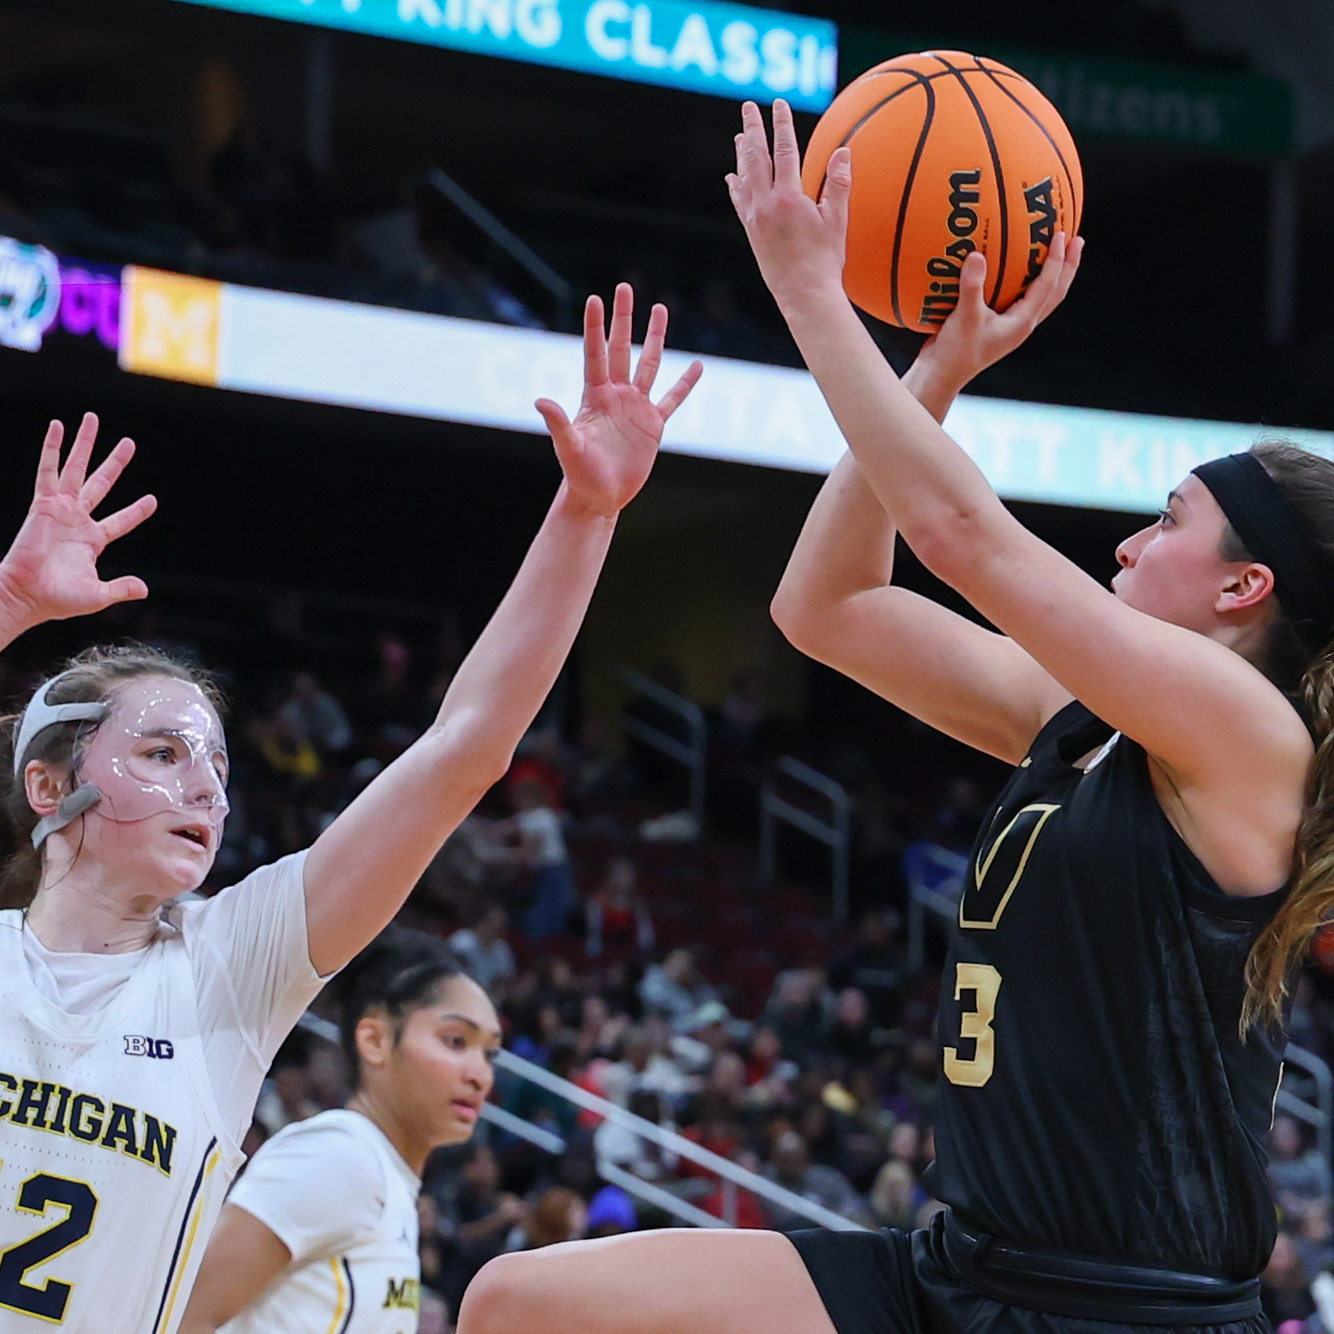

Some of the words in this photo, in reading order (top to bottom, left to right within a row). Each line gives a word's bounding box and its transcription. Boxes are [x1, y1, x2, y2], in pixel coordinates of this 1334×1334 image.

[917, 168, 981, 325] Wilson
[1021, 175, 1058, 290] CAA
[481, 346, 810, 446] COTTA
[1095, 428, 1229, 492] KIN
[943, 962, 1003, 1088] 3
